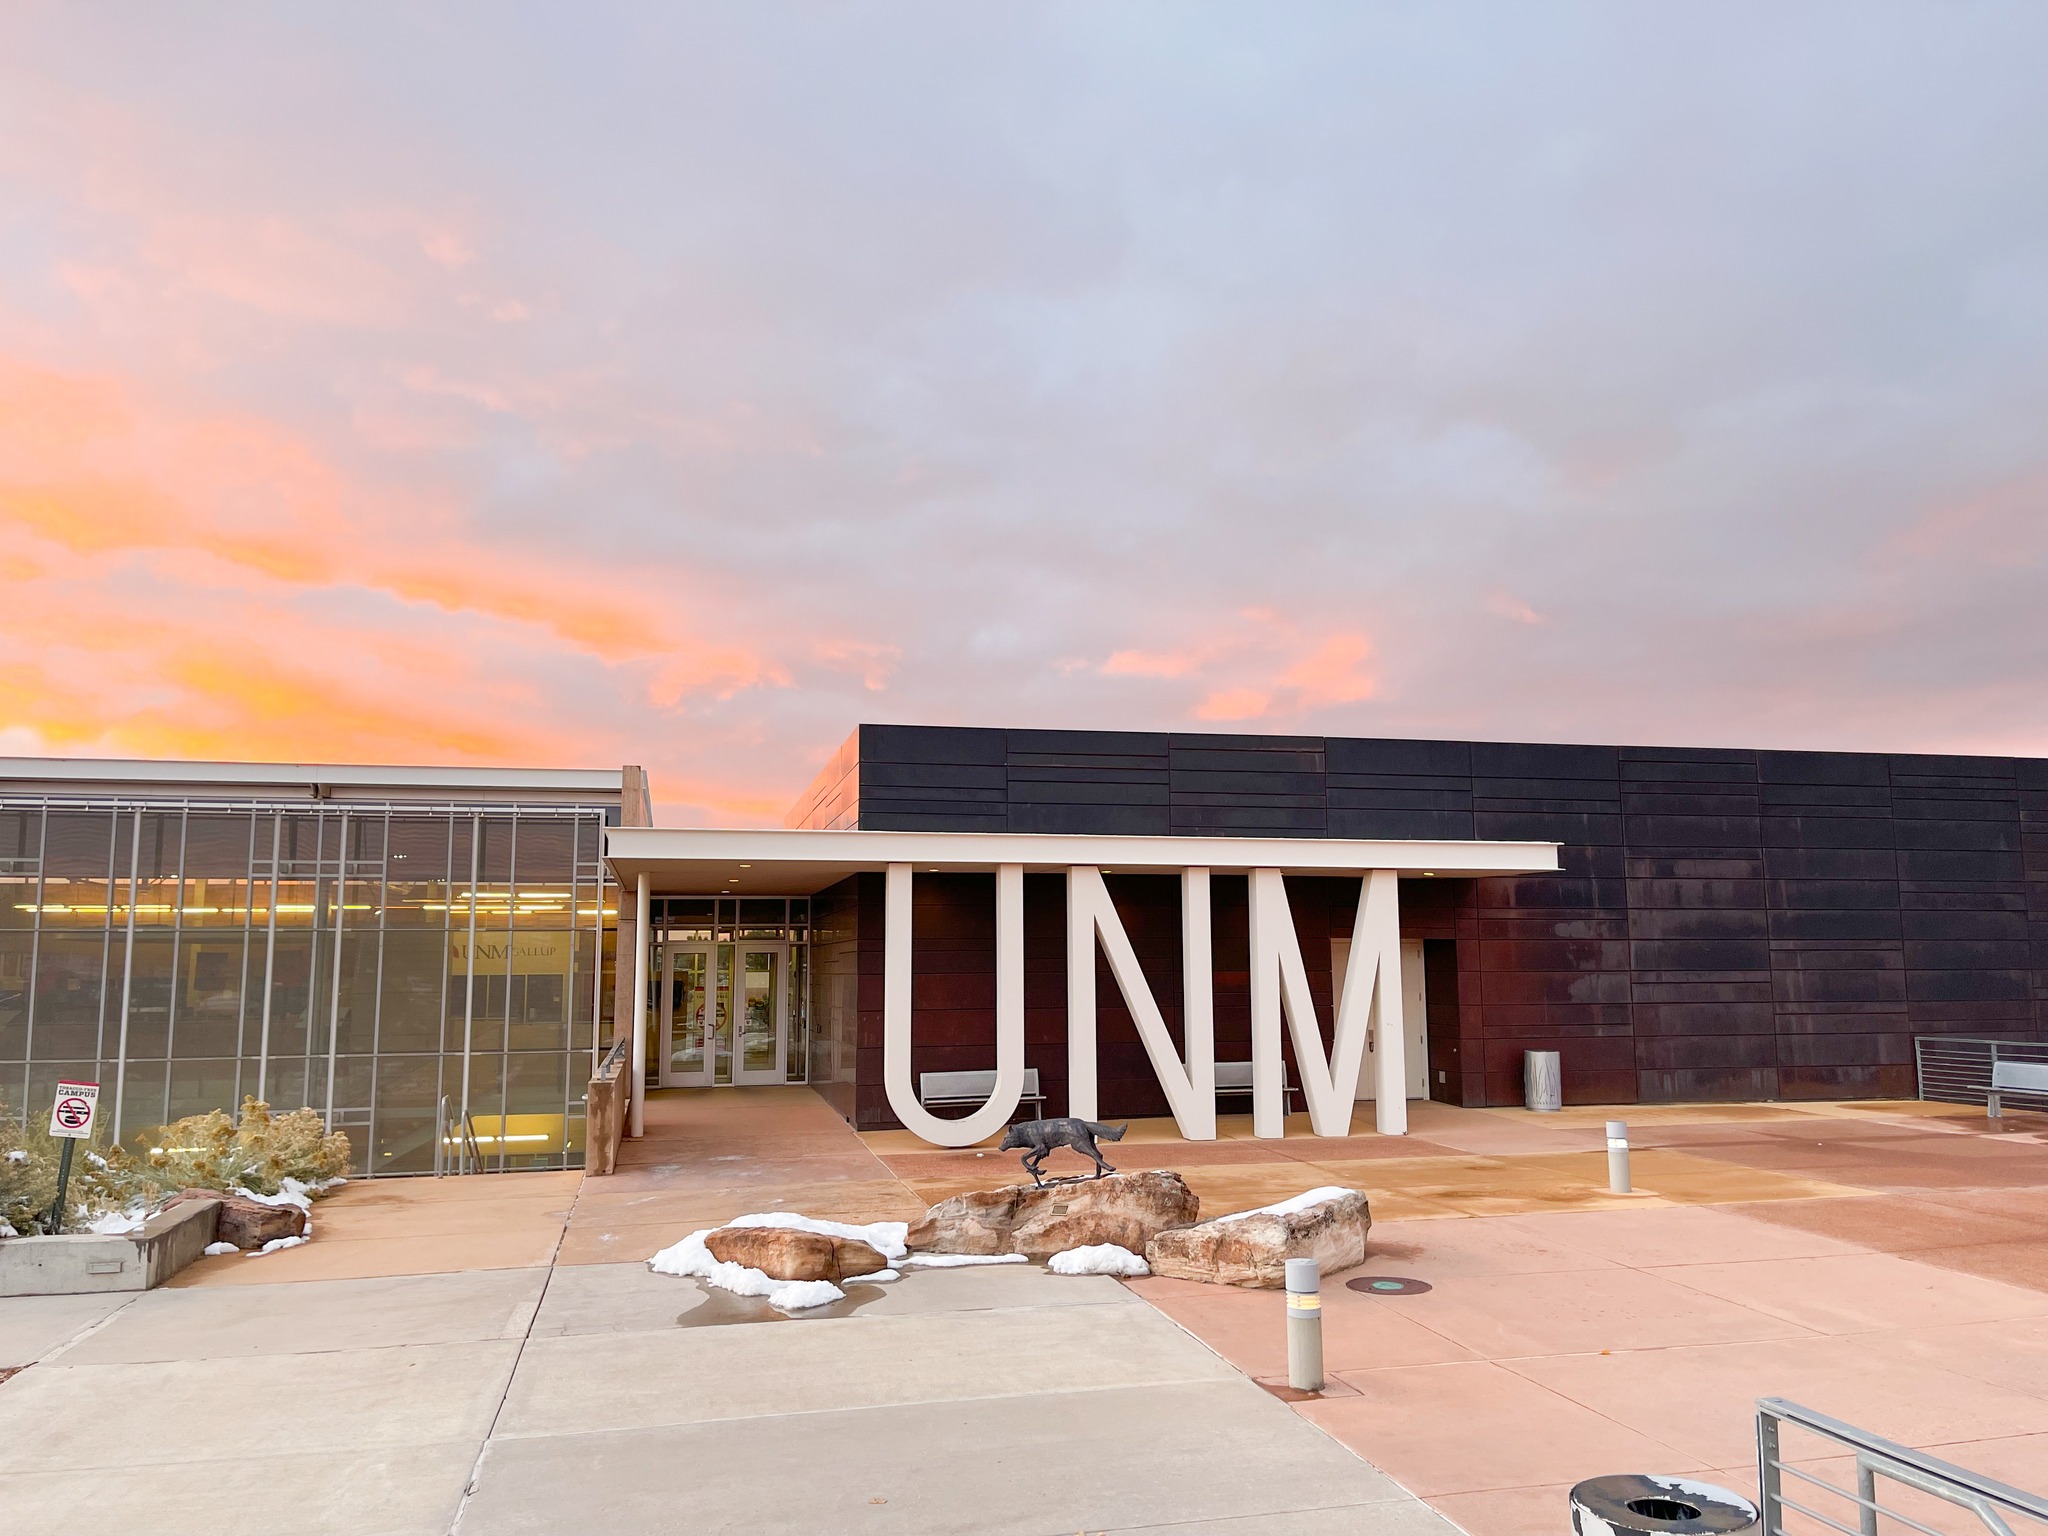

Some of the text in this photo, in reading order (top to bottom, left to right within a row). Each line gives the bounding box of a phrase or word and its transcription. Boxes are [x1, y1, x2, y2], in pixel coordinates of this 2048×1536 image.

[511, 946, 556, 957] GALLUP
[884, 862, 1407, 1148] UNM
[58, 1089, 96, 1098] CAMPUS
